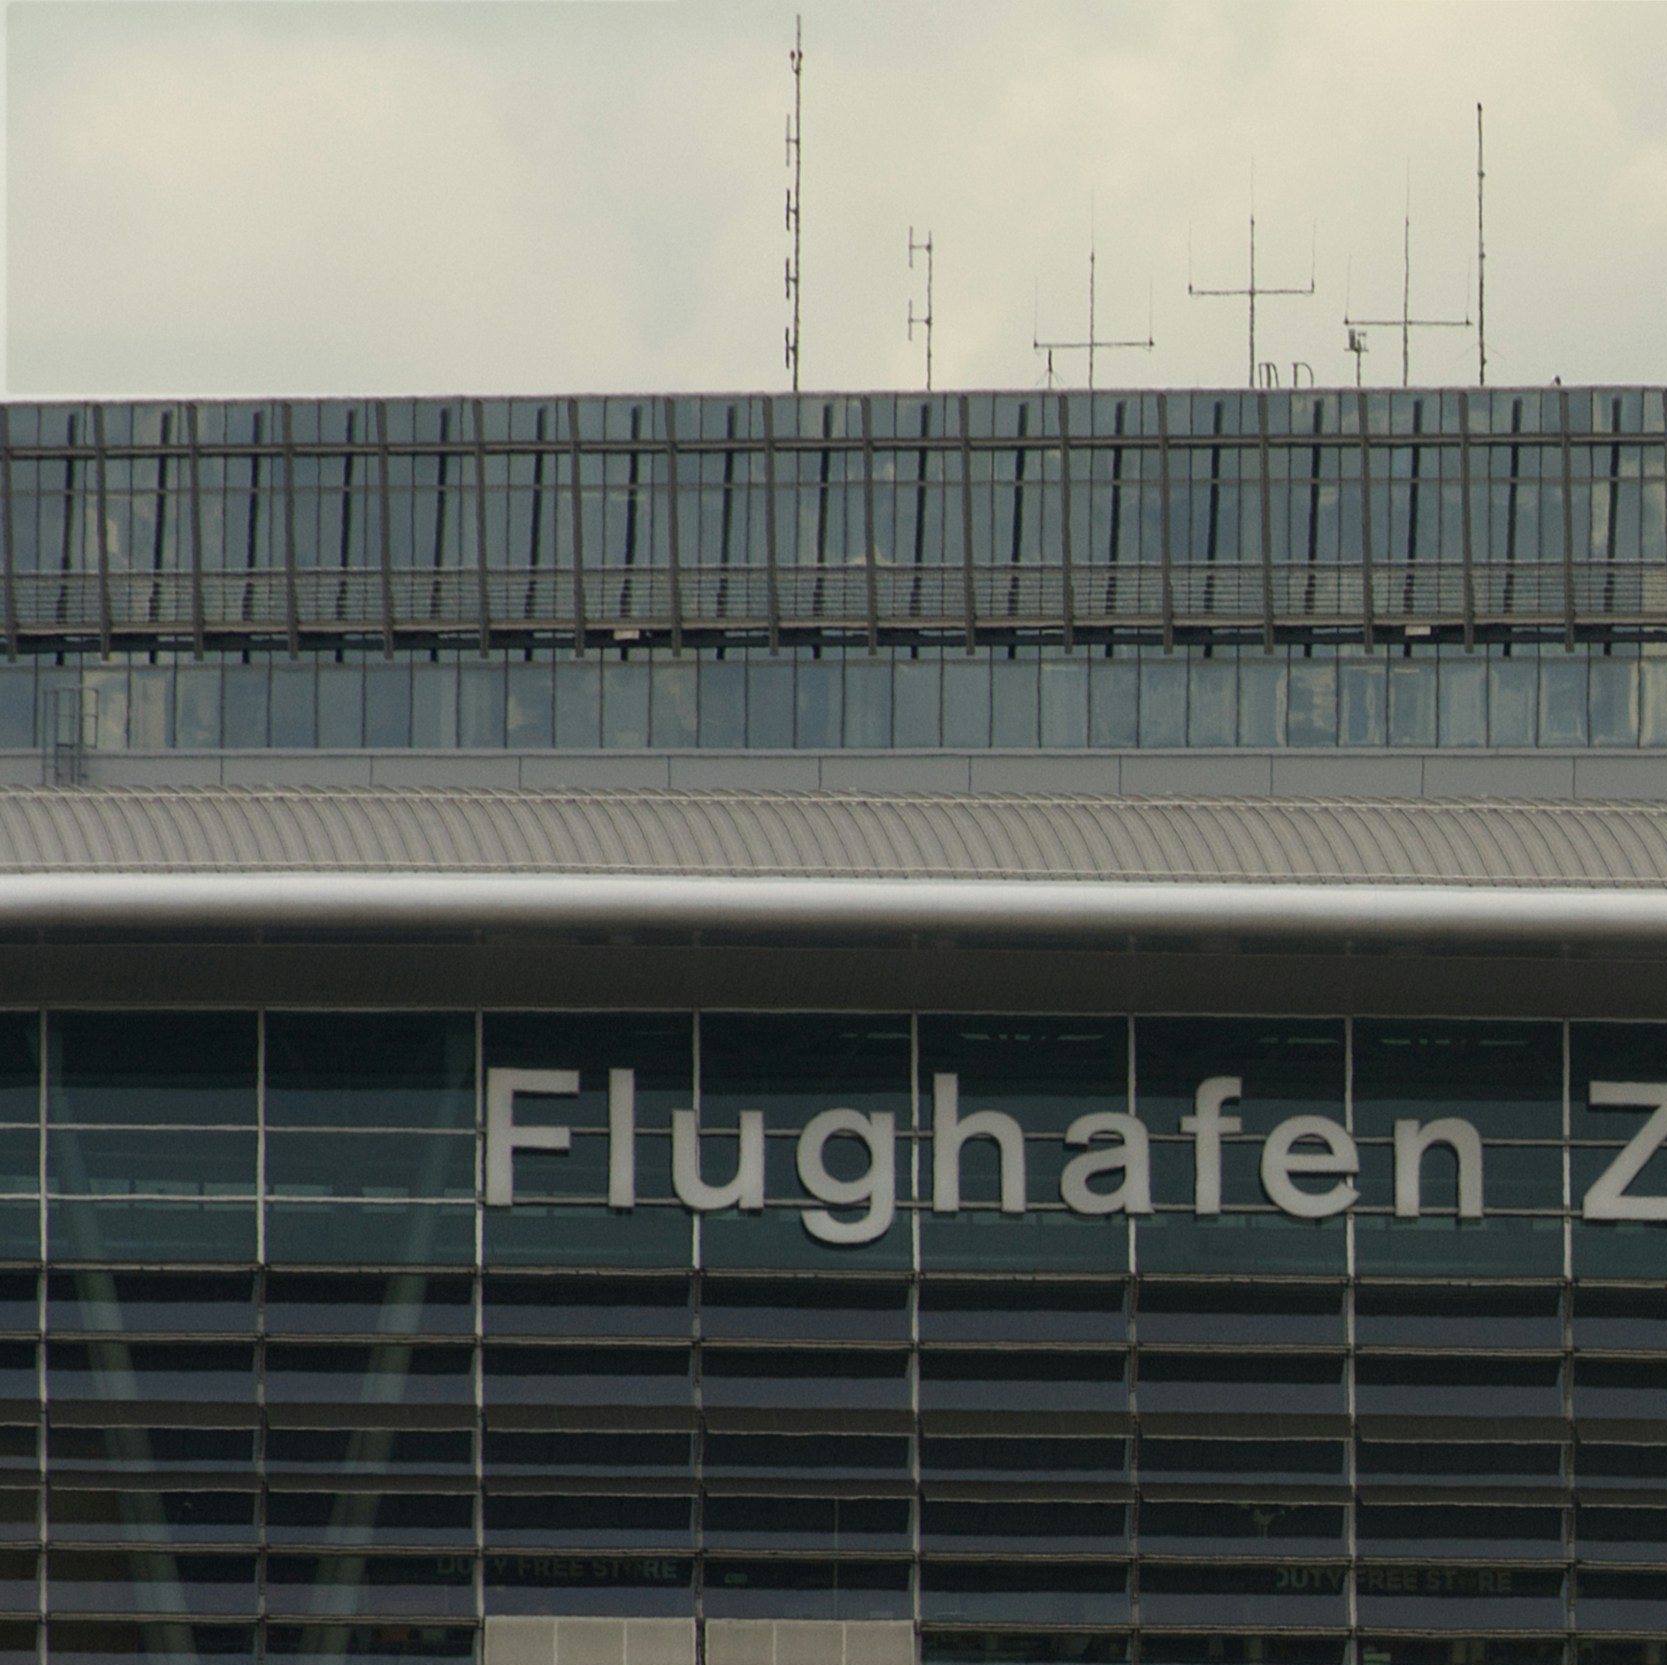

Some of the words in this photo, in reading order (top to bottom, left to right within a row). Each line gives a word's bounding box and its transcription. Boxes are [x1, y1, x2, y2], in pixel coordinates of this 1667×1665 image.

[484, 1067, 1486, 1245] Flughafen
[437, 1556, 508, 1575] DUY
[518, 1557, 583, 1577] FREE
